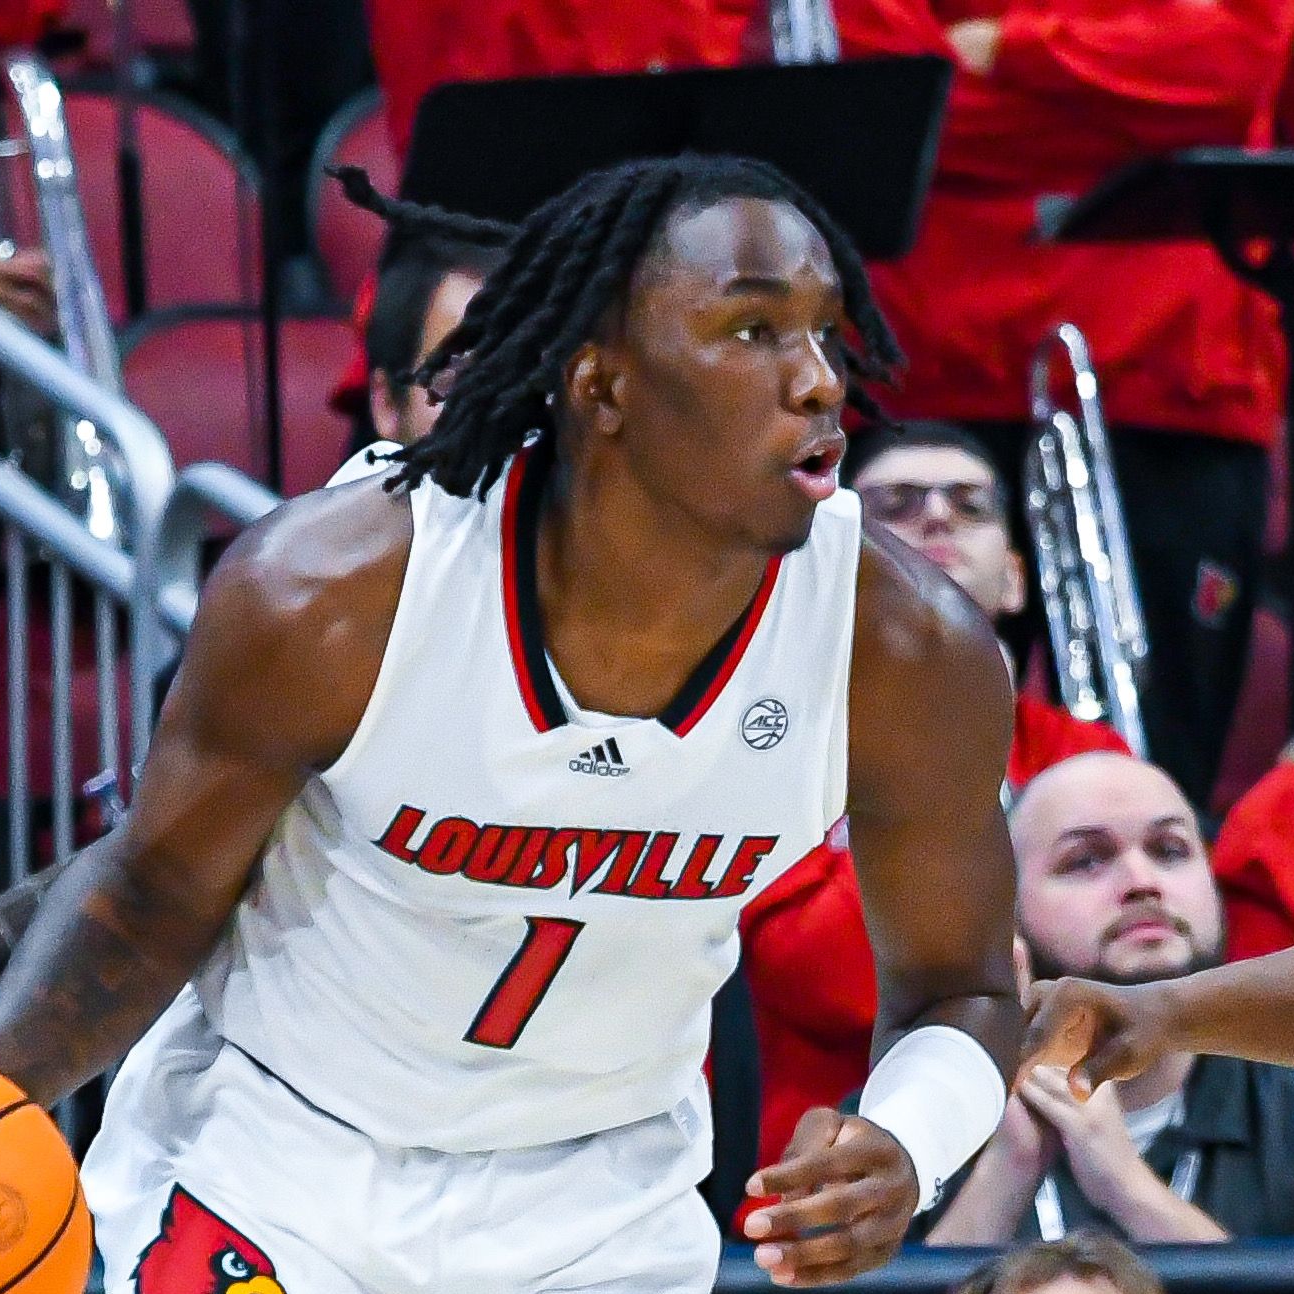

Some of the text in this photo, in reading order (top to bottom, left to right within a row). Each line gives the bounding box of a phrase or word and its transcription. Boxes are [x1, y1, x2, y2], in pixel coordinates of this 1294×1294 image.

[747, 714, 787, 730] ACC
[372, 803, 781, 900] LOUISVILLE
[463, 915, 586, 1050] 1
